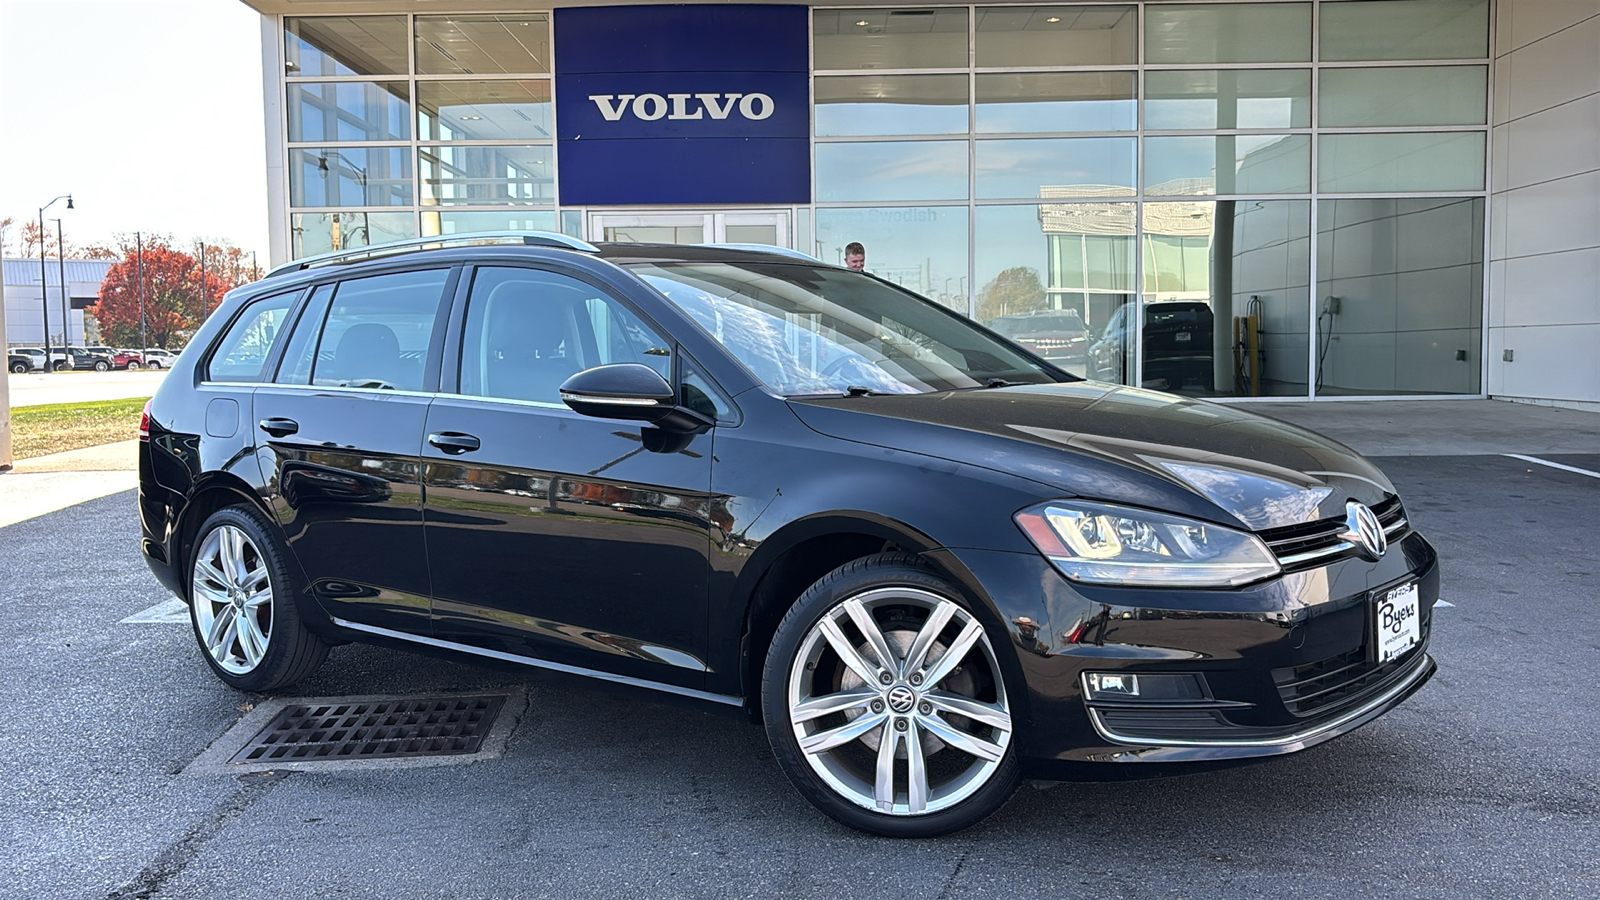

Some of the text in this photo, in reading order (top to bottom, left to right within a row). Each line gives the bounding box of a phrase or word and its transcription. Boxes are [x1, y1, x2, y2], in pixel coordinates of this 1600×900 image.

[588, 93, 775, 121] VOLVO
[868, 208, 938, 222] Swedish
[1379, 603, 1415, 633] Byers
